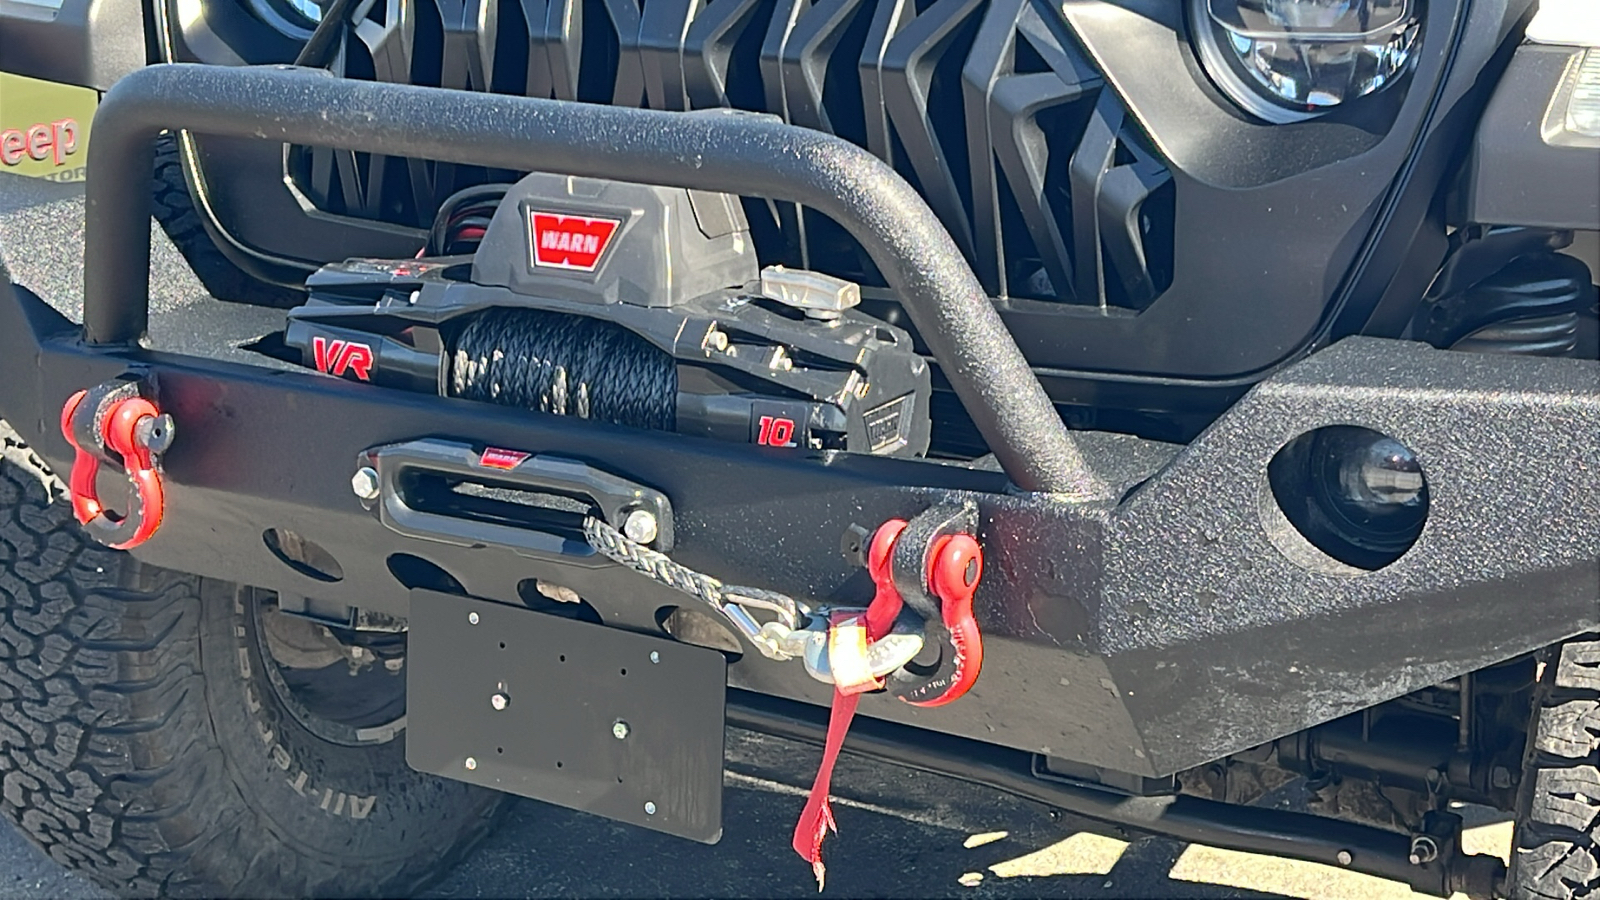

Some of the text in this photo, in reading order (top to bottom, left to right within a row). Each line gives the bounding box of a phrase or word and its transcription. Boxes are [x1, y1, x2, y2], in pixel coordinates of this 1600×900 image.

[0, 118, 79, 166] eep
[541, 229, 599, 254] WARN
[313, 336, 374, 381] VR
